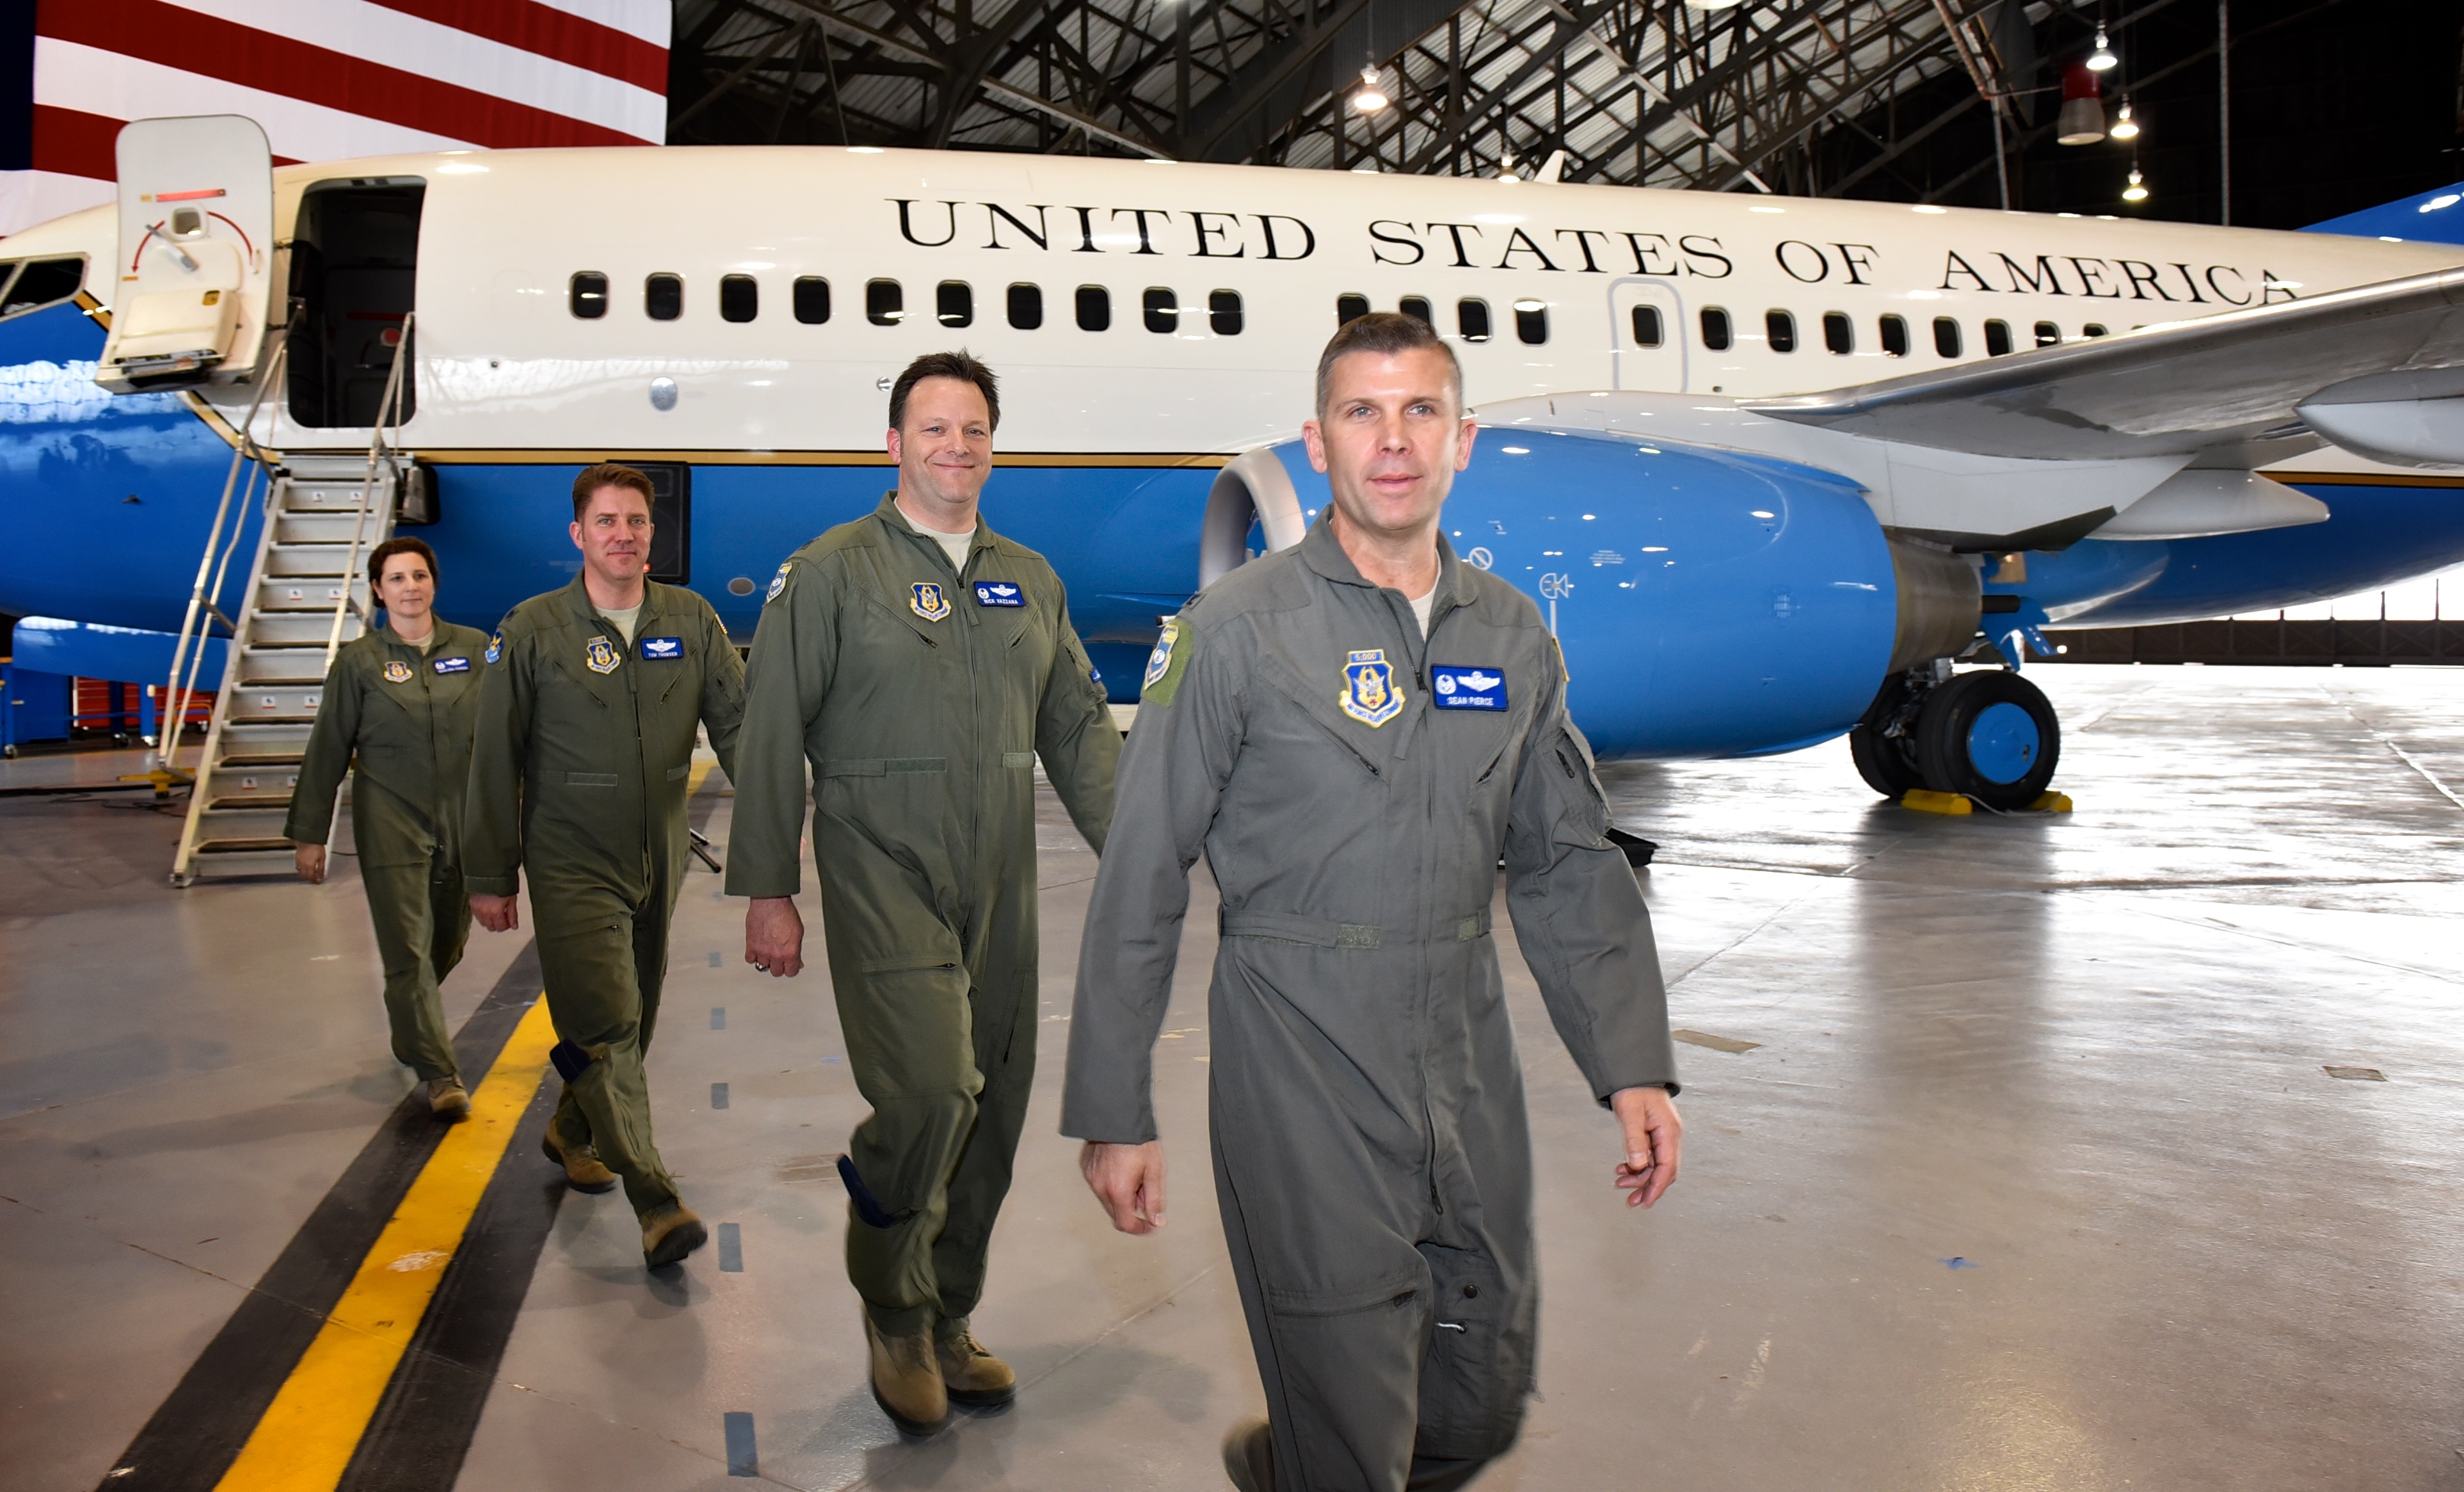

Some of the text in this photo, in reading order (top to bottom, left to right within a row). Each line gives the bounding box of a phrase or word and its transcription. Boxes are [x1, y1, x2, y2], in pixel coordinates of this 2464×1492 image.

[883, 199, 2298, 306] UNITED STATES OF AMERICA
[1355, 653, 1377, 661] 5,000
[1447, 696, 1494, 706] SEAN PIERCE
